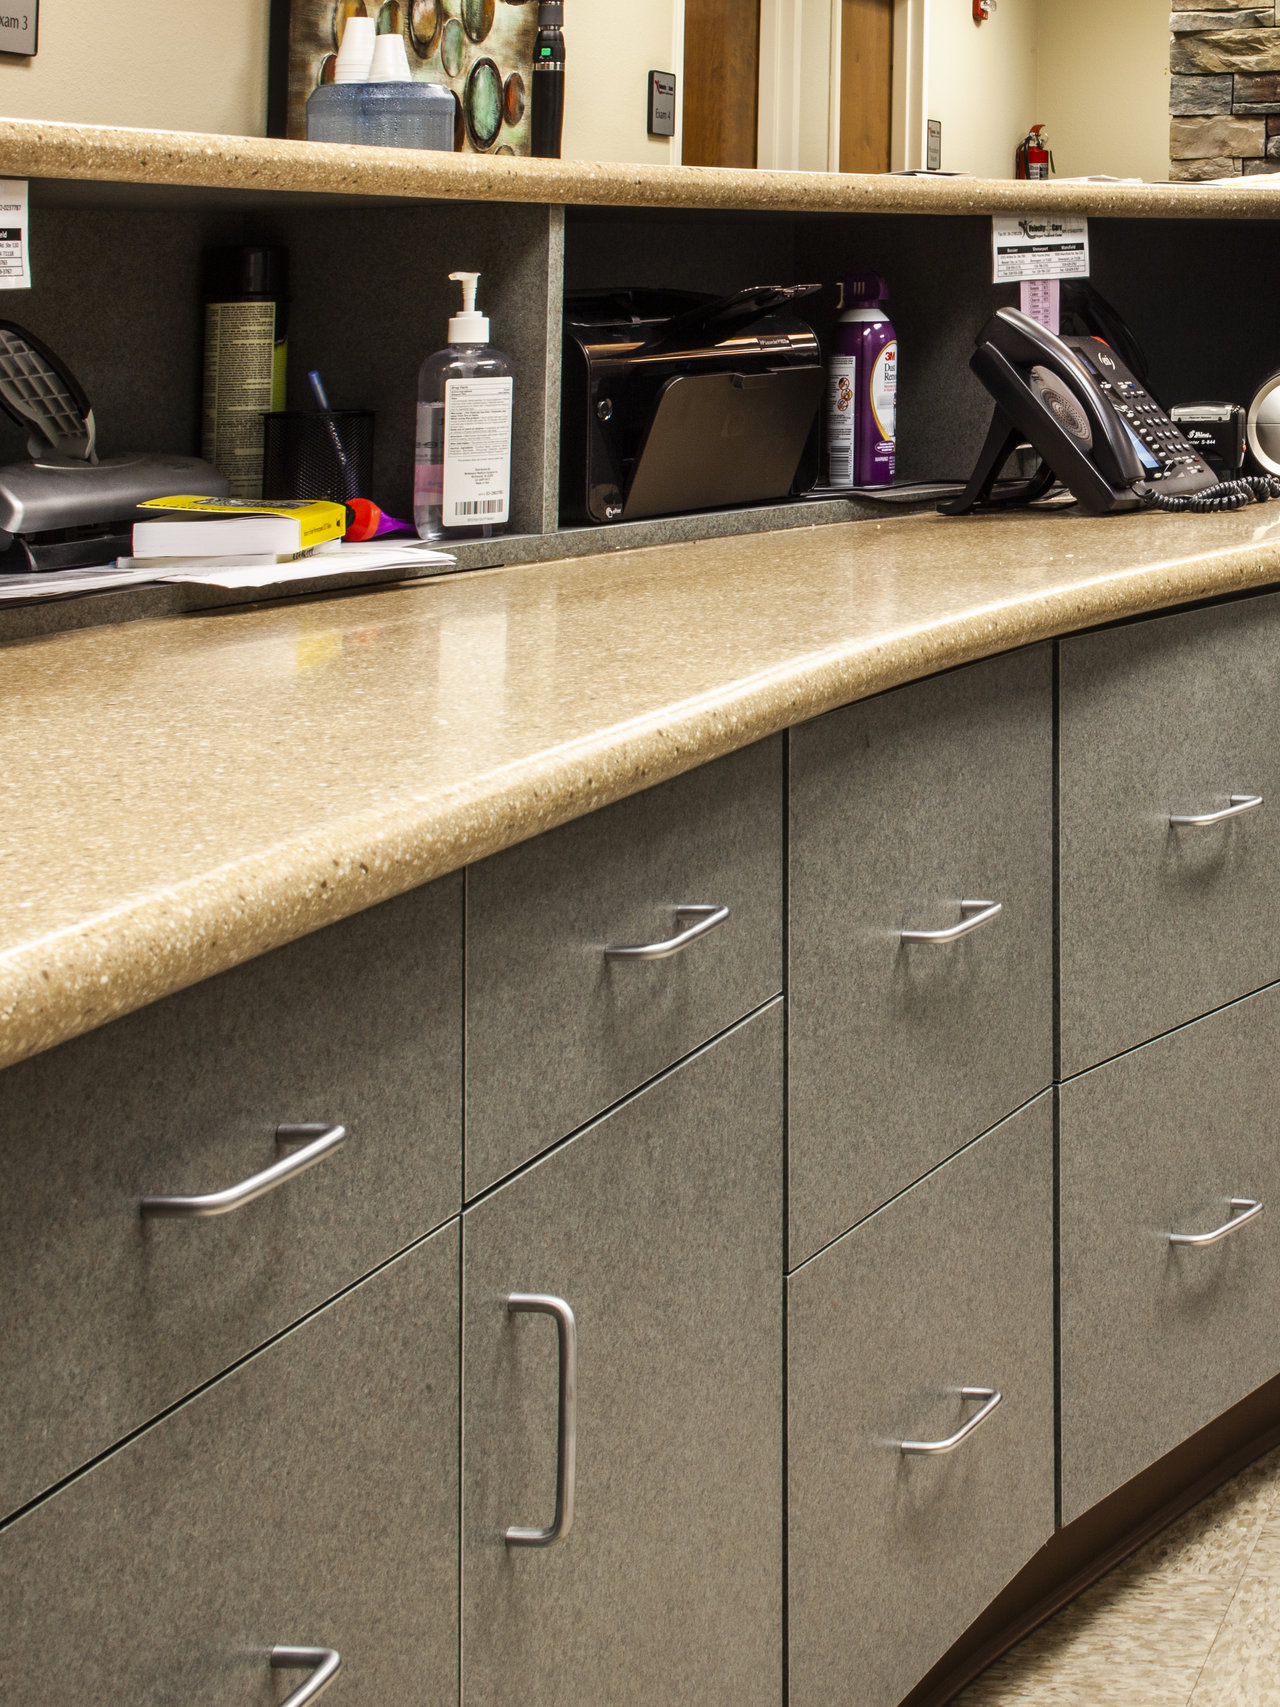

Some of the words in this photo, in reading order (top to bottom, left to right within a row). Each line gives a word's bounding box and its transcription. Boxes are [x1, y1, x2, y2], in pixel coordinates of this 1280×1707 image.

[0, 15, 19, 29] xam
[22, 15, 28, 30] 3
[885, 352, 896, 361] 3M
